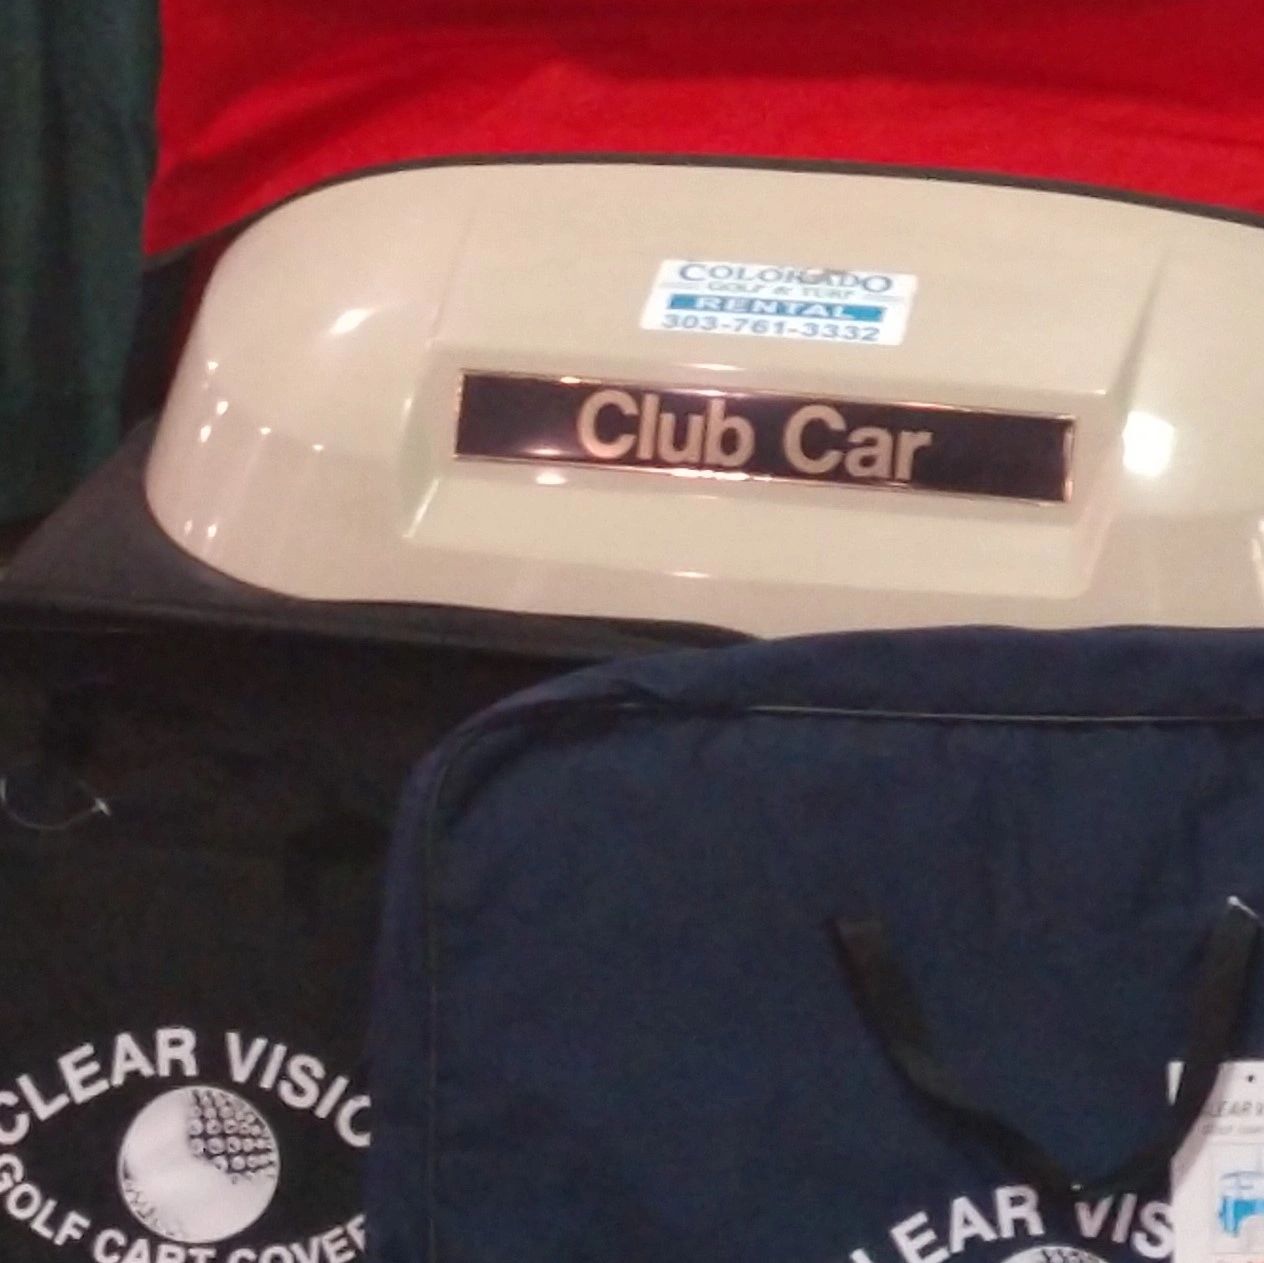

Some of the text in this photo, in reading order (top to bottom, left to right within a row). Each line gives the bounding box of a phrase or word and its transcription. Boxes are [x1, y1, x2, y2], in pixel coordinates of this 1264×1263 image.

[694, 295, 855, 320] RENTAL
[662, 313, 881, 342] 303-761-3332
[577, 389, 933, 481] Club Car
